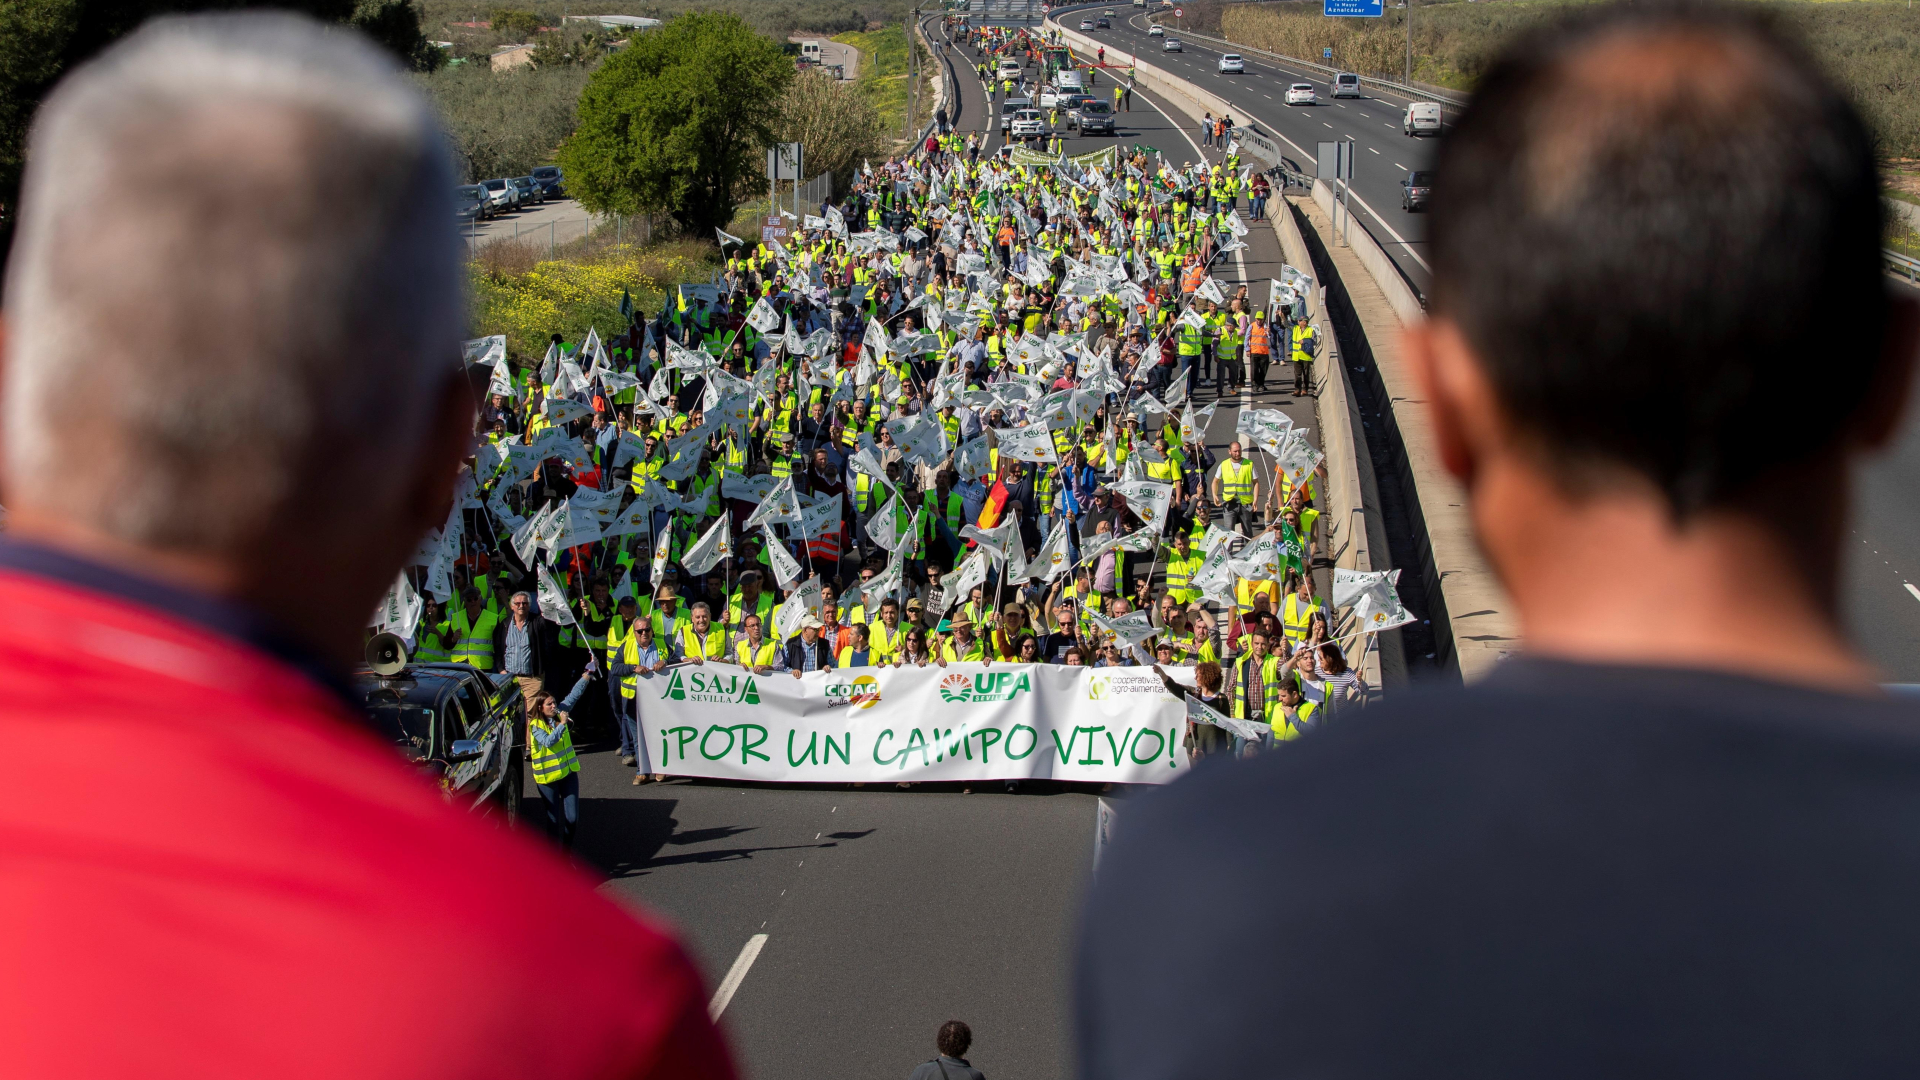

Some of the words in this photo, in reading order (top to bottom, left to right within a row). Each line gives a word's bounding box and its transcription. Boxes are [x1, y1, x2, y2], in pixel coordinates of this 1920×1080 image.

[1028, 338, 1041, 348] UPA
[660, 668, 761, 705] ASAJA
[974, 671, 1031, 698] UPA
[1112, 676, 1161, 686] cooperativas
[825, 683, 877, 697] COAG
[690, 694, 732, 704] SEVILLA
[828, 696, 848, 709] Sevilla
[660, 723, 771, 767] ¡POR
[787, 728, 851, 768] UN
[873, 723, 1038, 770] CAMPO
[1051, 725, 1177, 768] VIVO!
